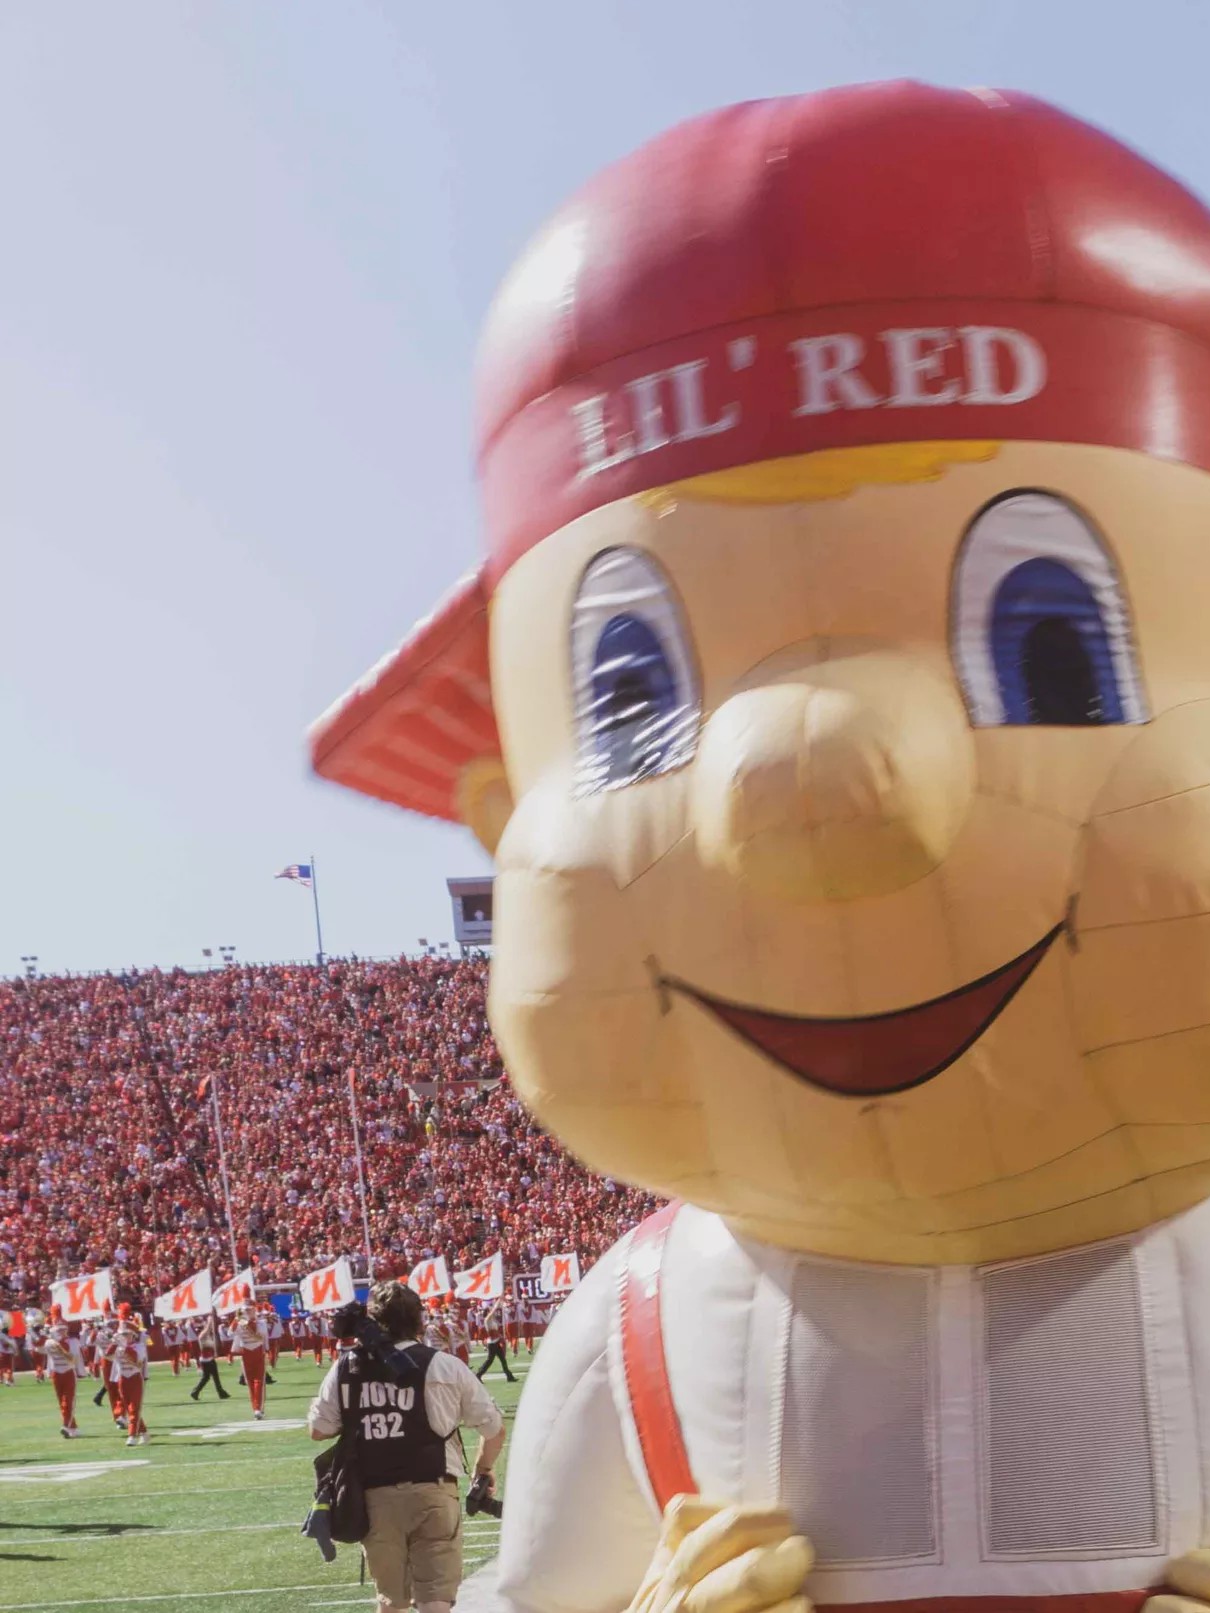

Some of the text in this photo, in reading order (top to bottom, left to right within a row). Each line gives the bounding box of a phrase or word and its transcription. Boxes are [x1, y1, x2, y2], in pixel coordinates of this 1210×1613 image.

[570, 324, 1048, 480] LIL' RED
[361, 1412, 405, 1440] 132
